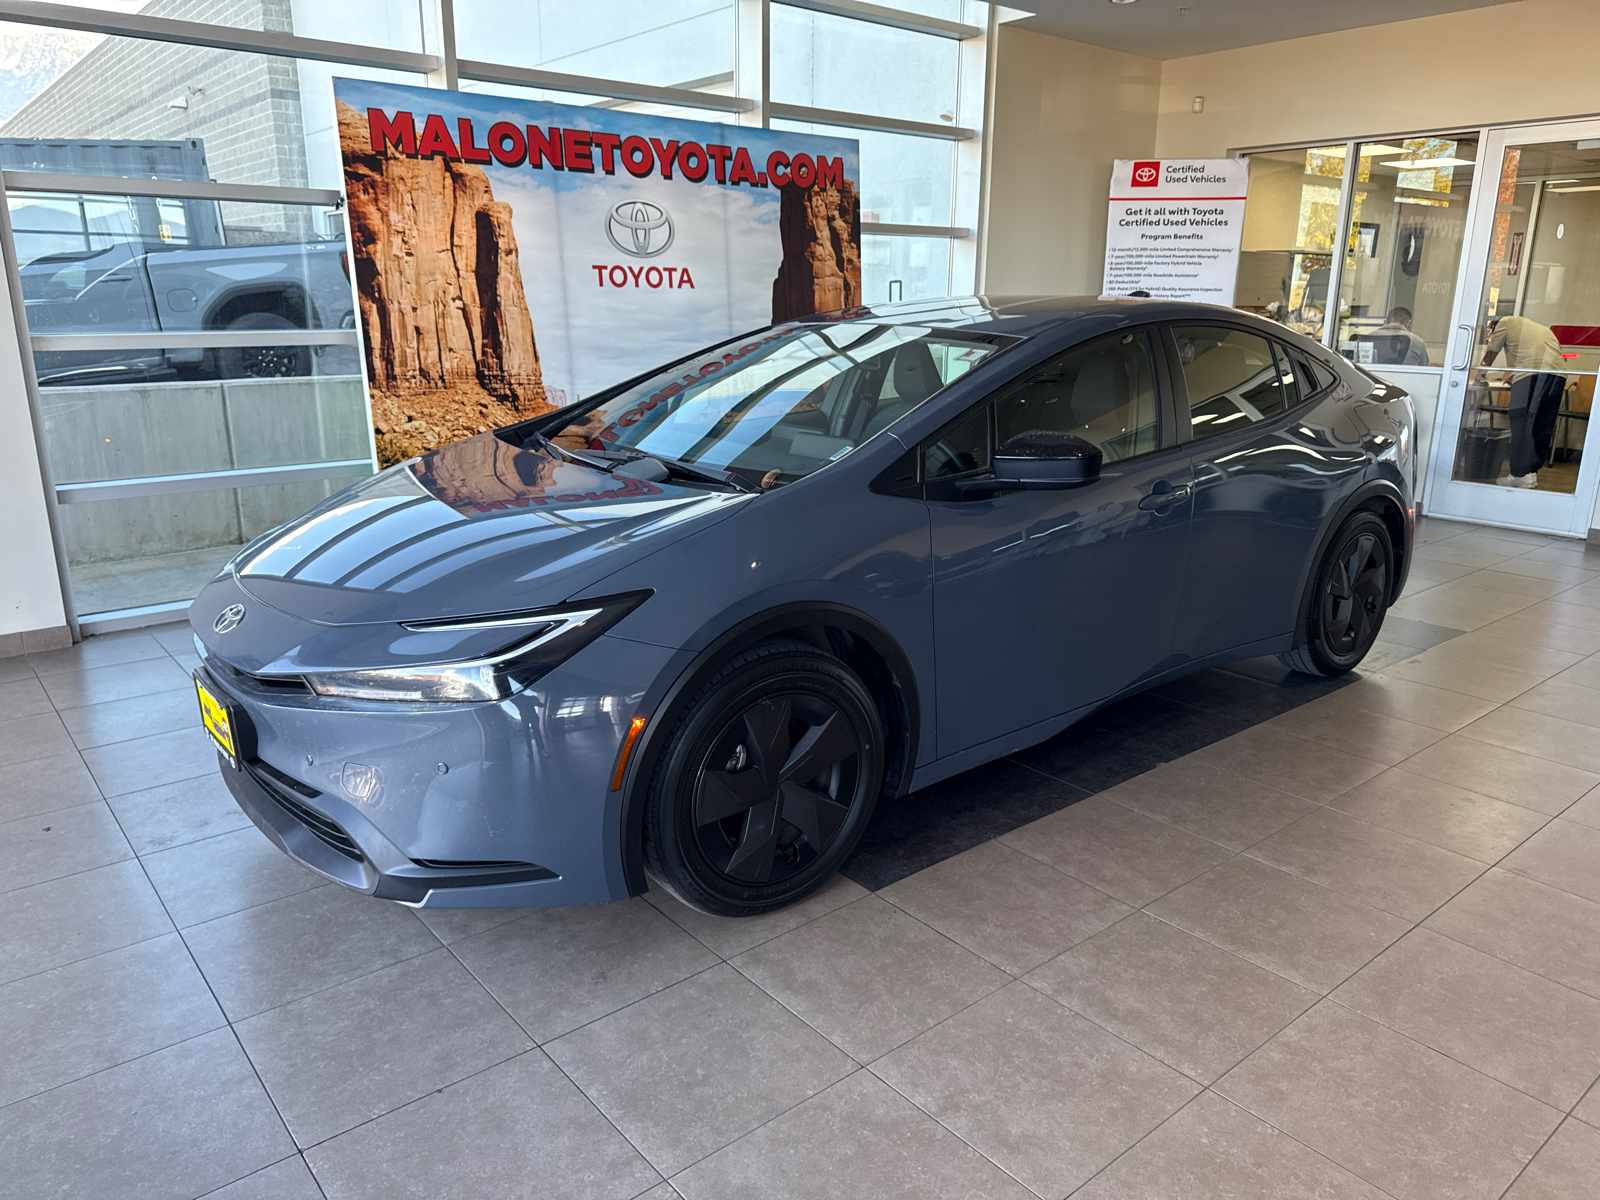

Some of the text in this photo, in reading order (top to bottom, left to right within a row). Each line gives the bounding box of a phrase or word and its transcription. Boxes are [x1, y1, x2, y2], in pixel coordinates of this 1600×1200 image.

[366, 107, 844, 191] MALONETOYOTA.COM
[1166, 165, 1205, 173] Certified
[1165, 175, 1226, 183] Used Vehicles
[1125, 208, 1143, 216] Get
[1154, 207, 1166, 216] all
[1168, 208, 1190, 216] with
[1192, 207, 1224, 217] Toyota
[1119, 218, 1228, 227] Certified Used Vehicles
[1141, 233, 1172, 242] Program
[592, 264, 695, 290] TOYOTA
